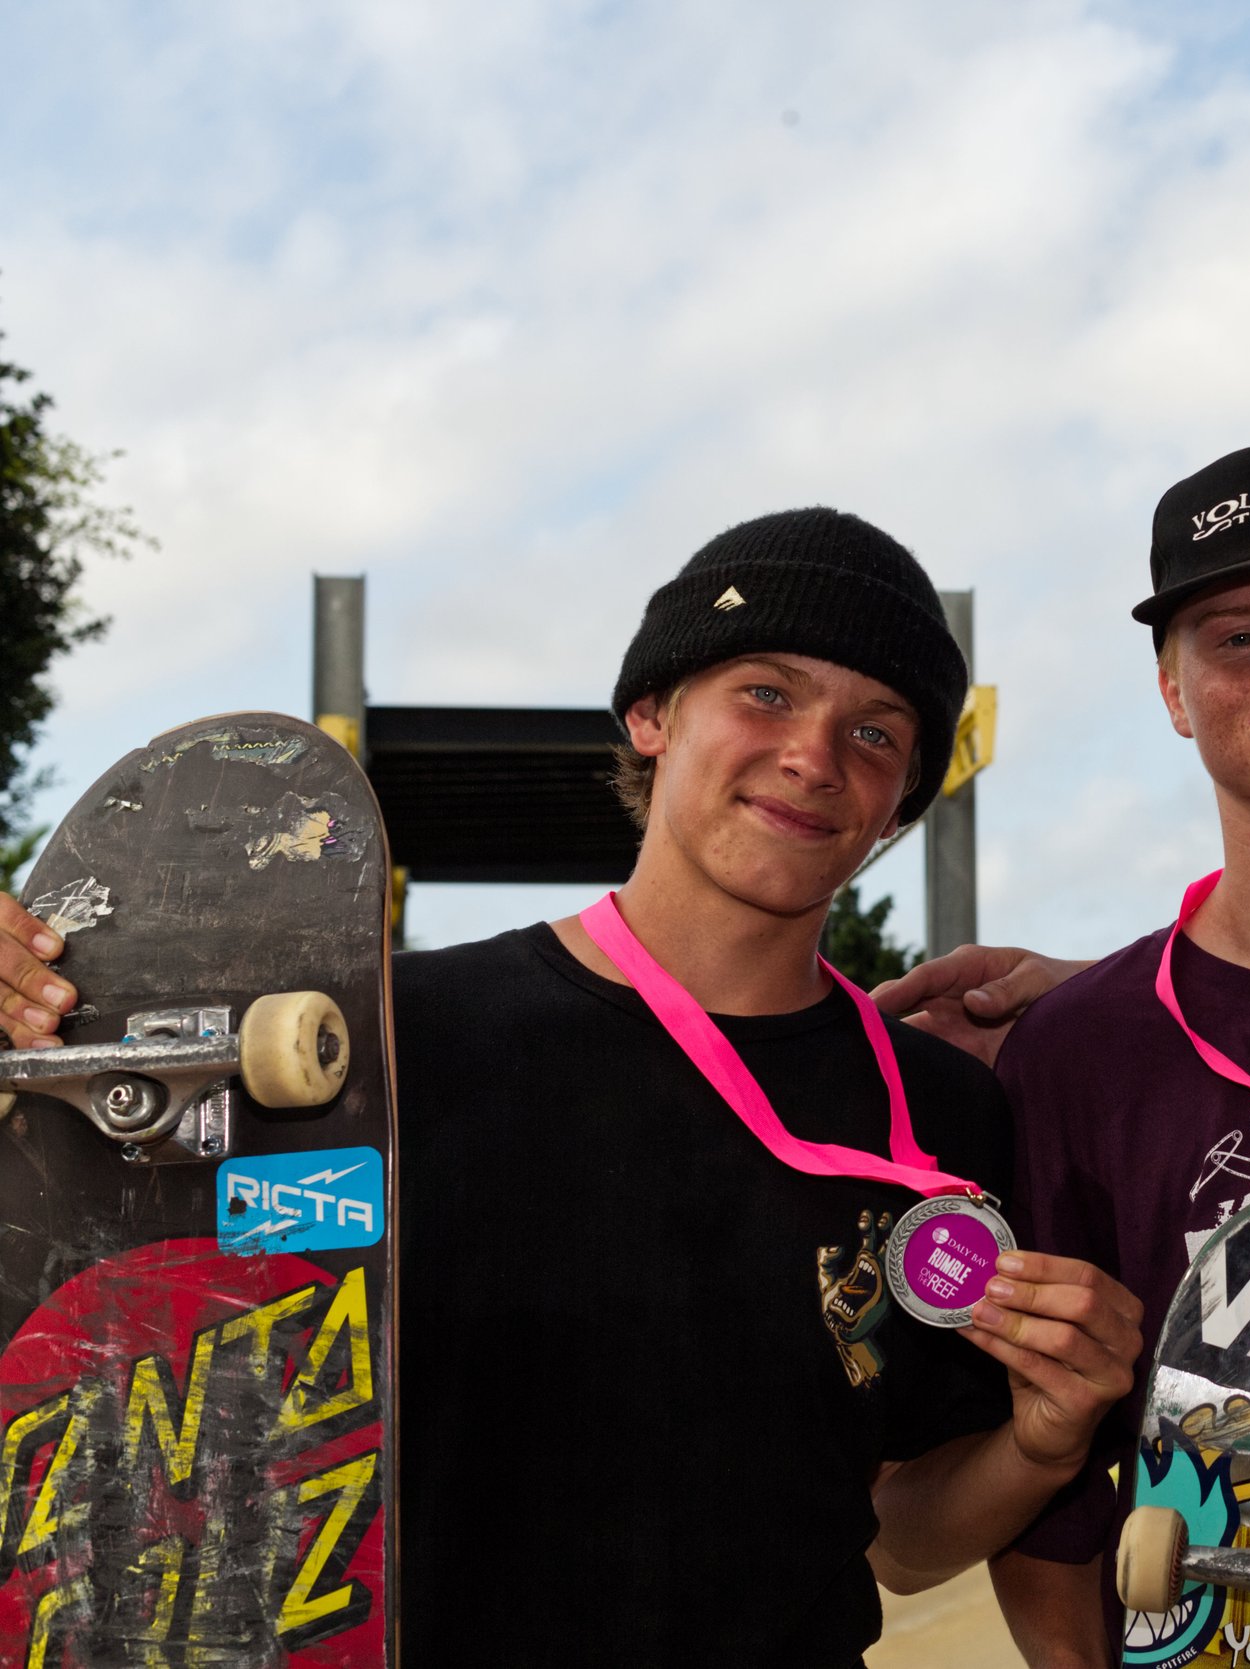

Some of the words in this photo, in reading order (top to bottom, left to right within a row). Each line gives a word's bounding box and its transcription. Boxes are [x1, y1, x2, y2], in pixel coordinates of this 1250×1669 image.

[227, 1173, 373, 1232] RICTA
[927, 1247, 972, 1285] RUMBLE
[947, 1238, 972, 1257] DALY
[971, 1253, 989, 1267] BAY
[920, 1267, 934, 1280] ON
[926, 1273, 959, 1300] REEF
